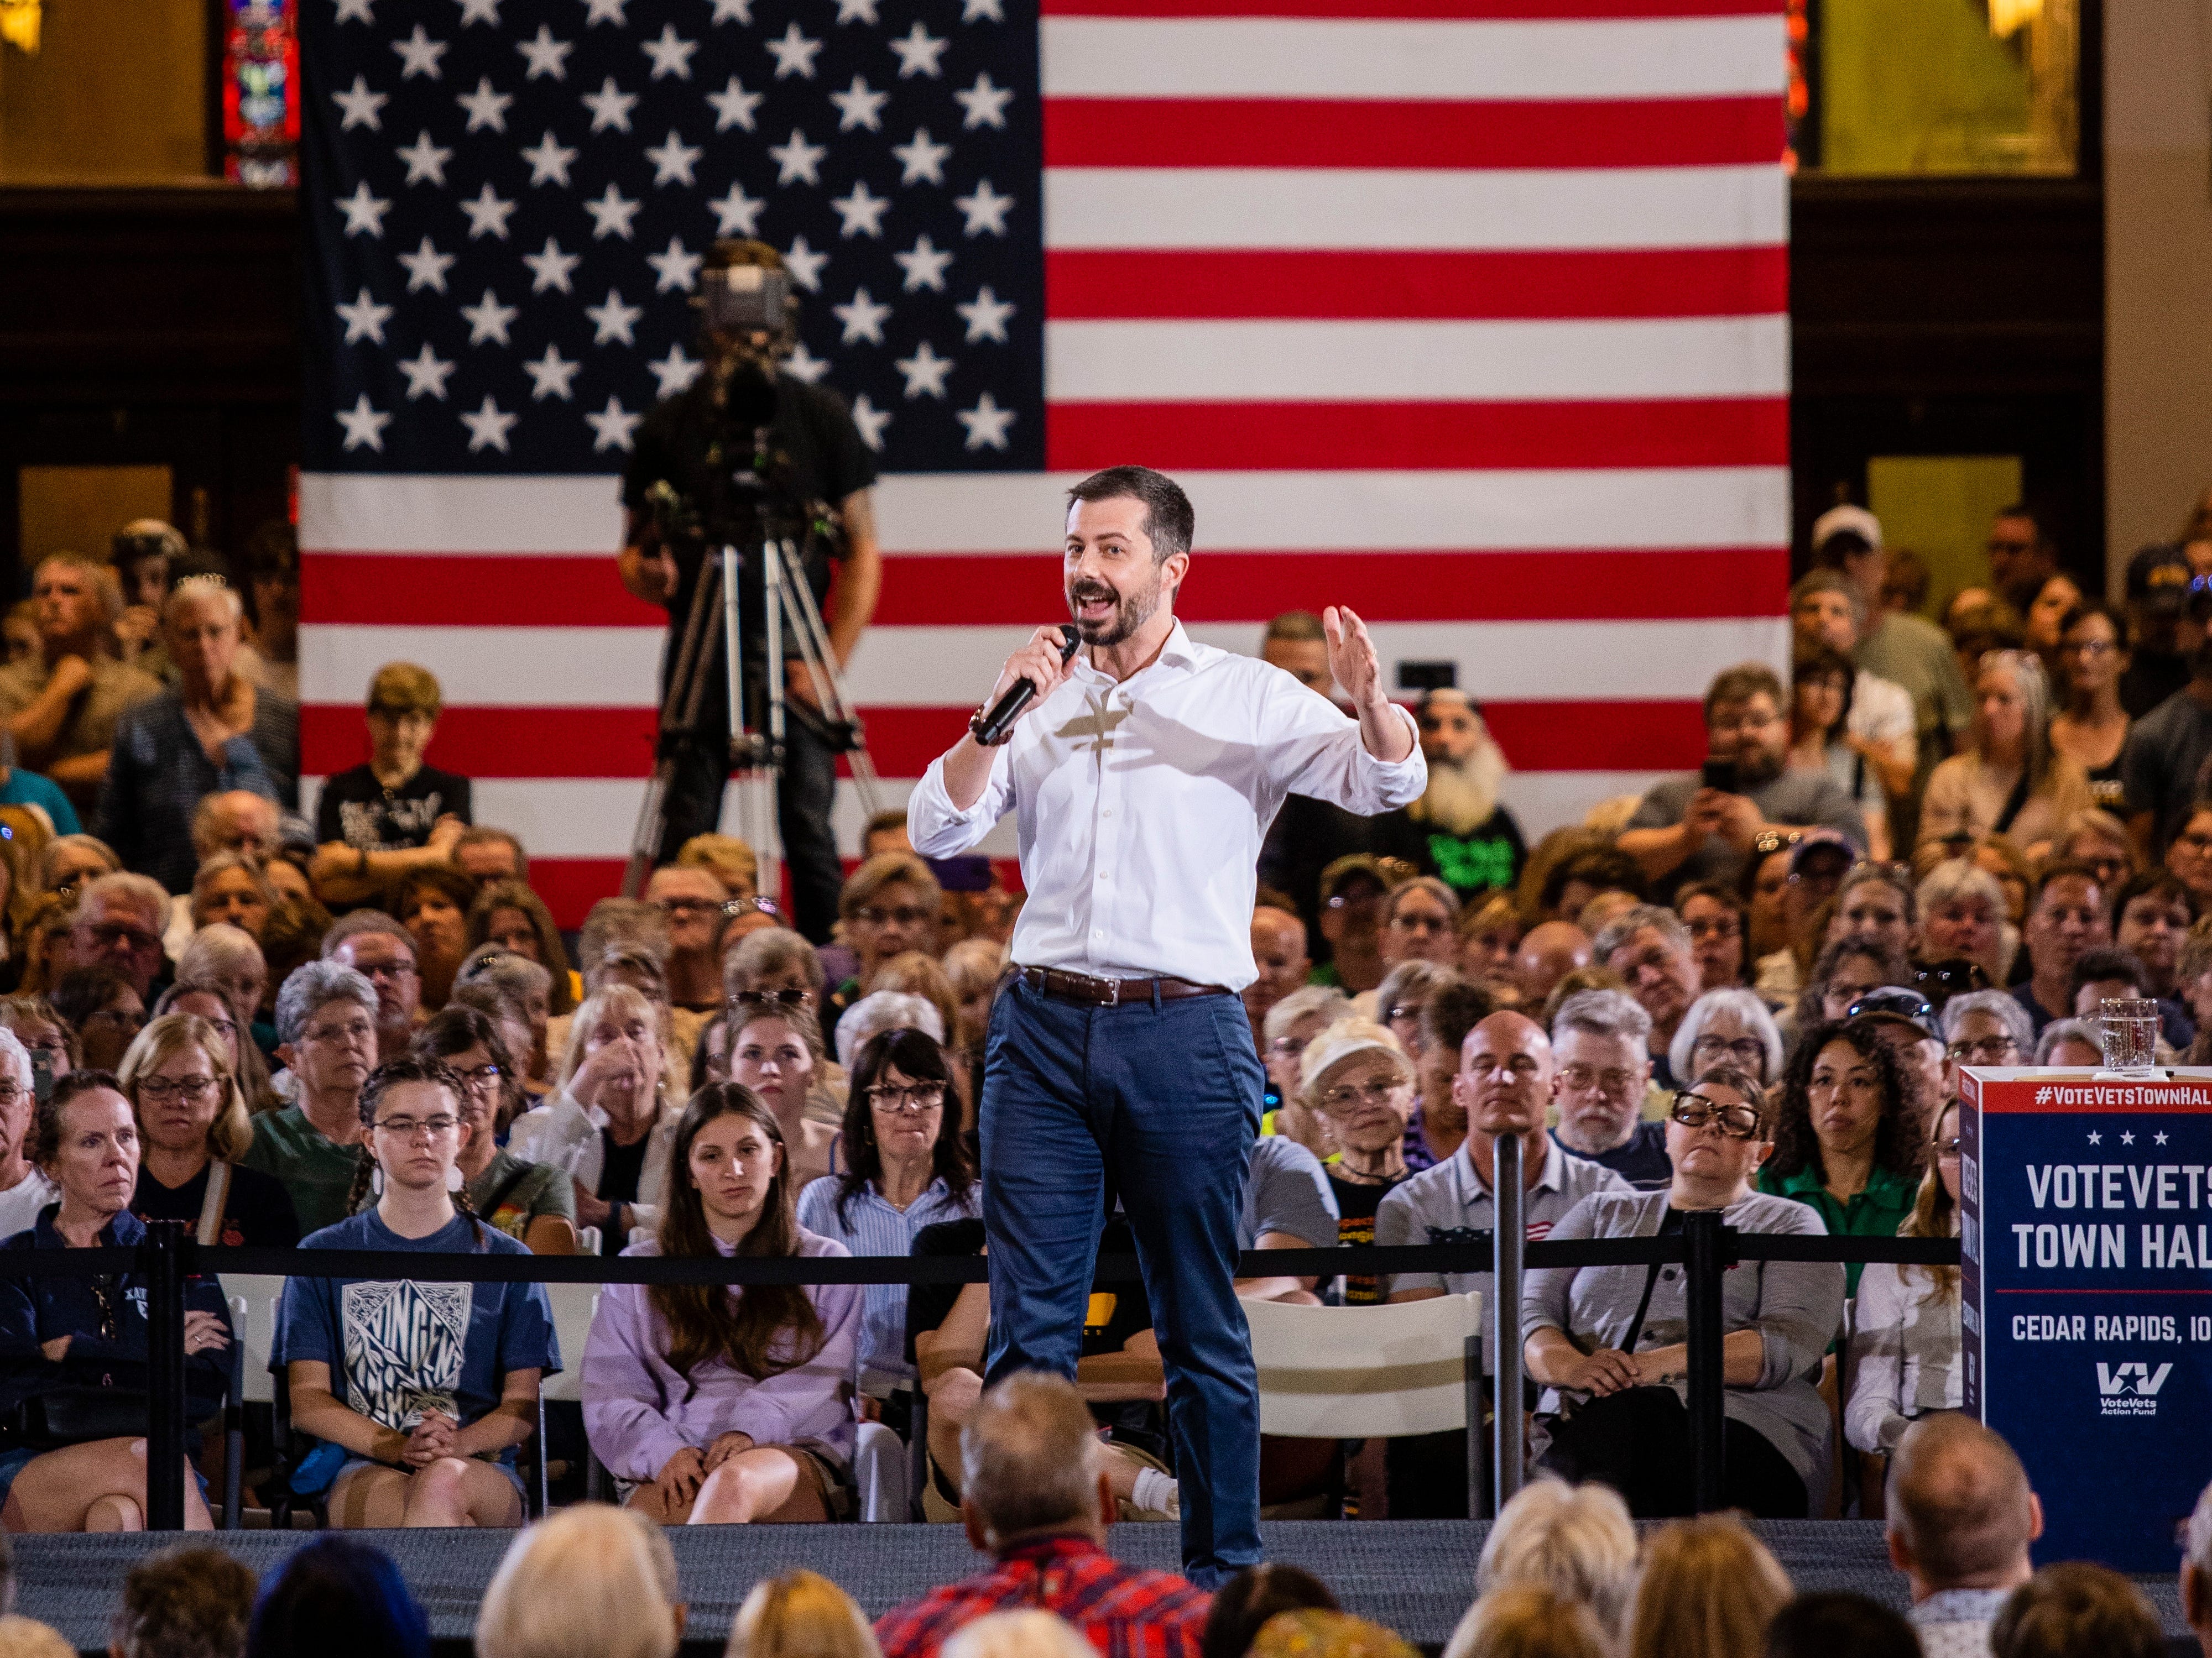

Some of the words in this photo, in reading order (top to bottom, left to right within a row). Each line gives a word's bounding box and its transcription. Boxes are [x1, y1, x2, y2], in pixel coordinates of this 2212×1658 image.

[2026, 1165, 2212, 1209] VOTEVET
[2012, 1224, 2125, 1268] TOWN
[2142, 1225, 2212, 1268] HAL
[2012, 1315, 2086, 1341] CEDAR
[2094, 1316, 2182, 1344] RAPIDS,
[2190, 1316, 2211, 1341] IO
[2100, 1398, 2157, 1408] VoteVets
